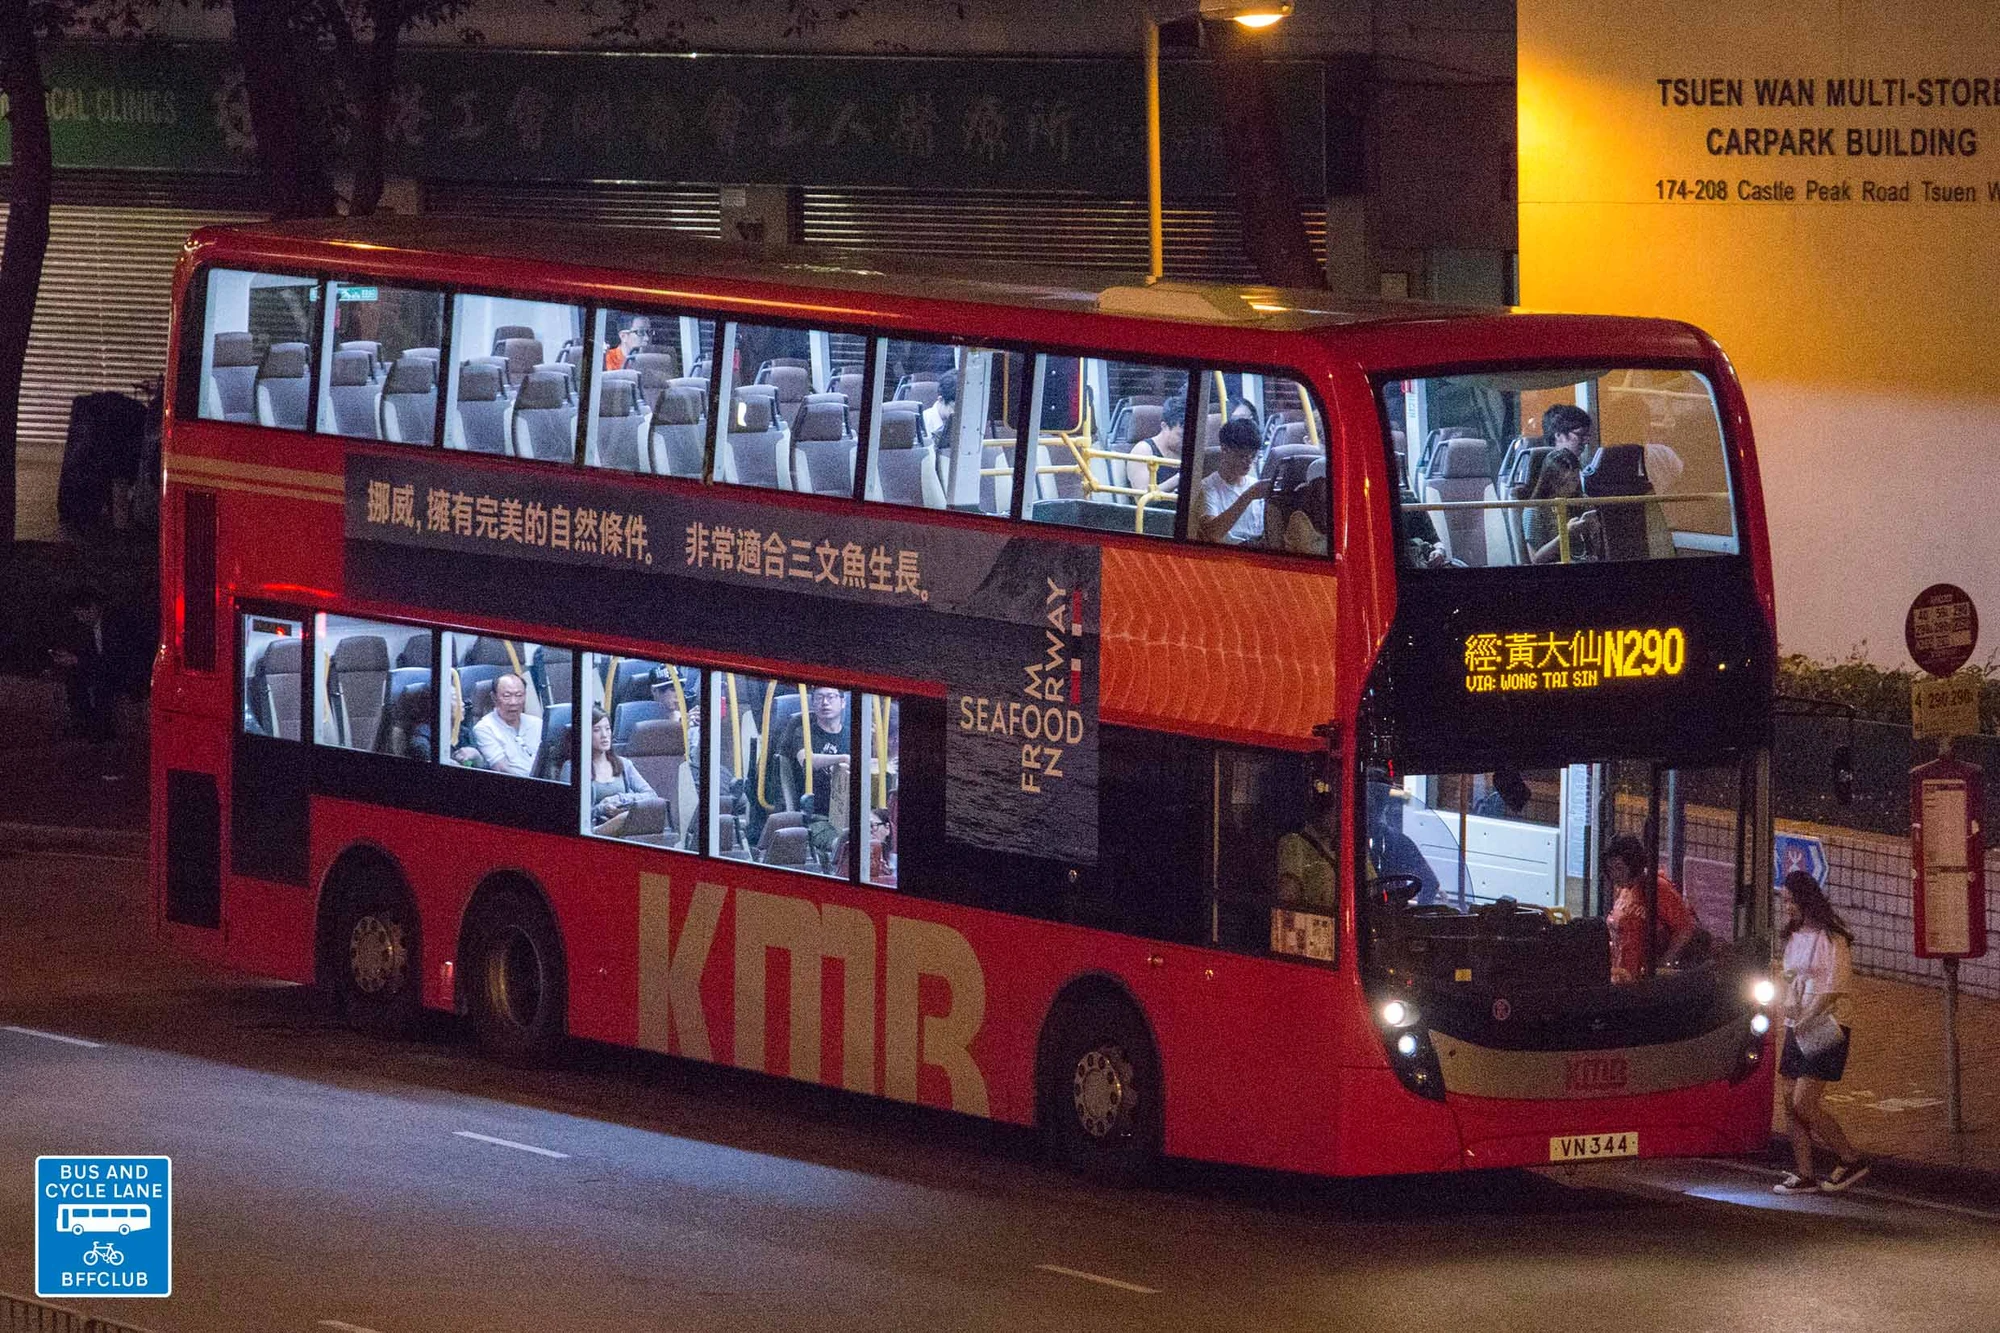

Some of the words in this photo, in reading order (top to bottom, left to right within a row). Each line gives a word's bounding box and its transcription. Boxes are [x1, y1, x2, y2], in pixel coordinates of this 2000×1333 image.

[96, 87, 177, 124] CLINICS
[1657, 78, 1743, 107] TSUEN
[1754, 79, 1815, 107] WAN
[1706, 127, 1836, 157] CARPARK
[1846, 128, 1978, 158] BUILDING
[1655, 179, 1728, 201] 174-208
[1737, 179, 1795, 201] Castle
[1805, 180, 1851, 201] Peak
[1862, 180, 1910, 202] Road
[1922, 180, 1977, 203] Tsuen
[1603, 627, 1685, 678] N290
[1465, 675, 1497, 693] VIA:
[1500, 673, 1538, 691] WONG
[1542, 672, 1568, 689] TAI
[1572, 670, 1598, 687] SIN
[959, 695, 1084, 744] SEAFOOD
[1562, 1135, 1628, 1157] VN344
